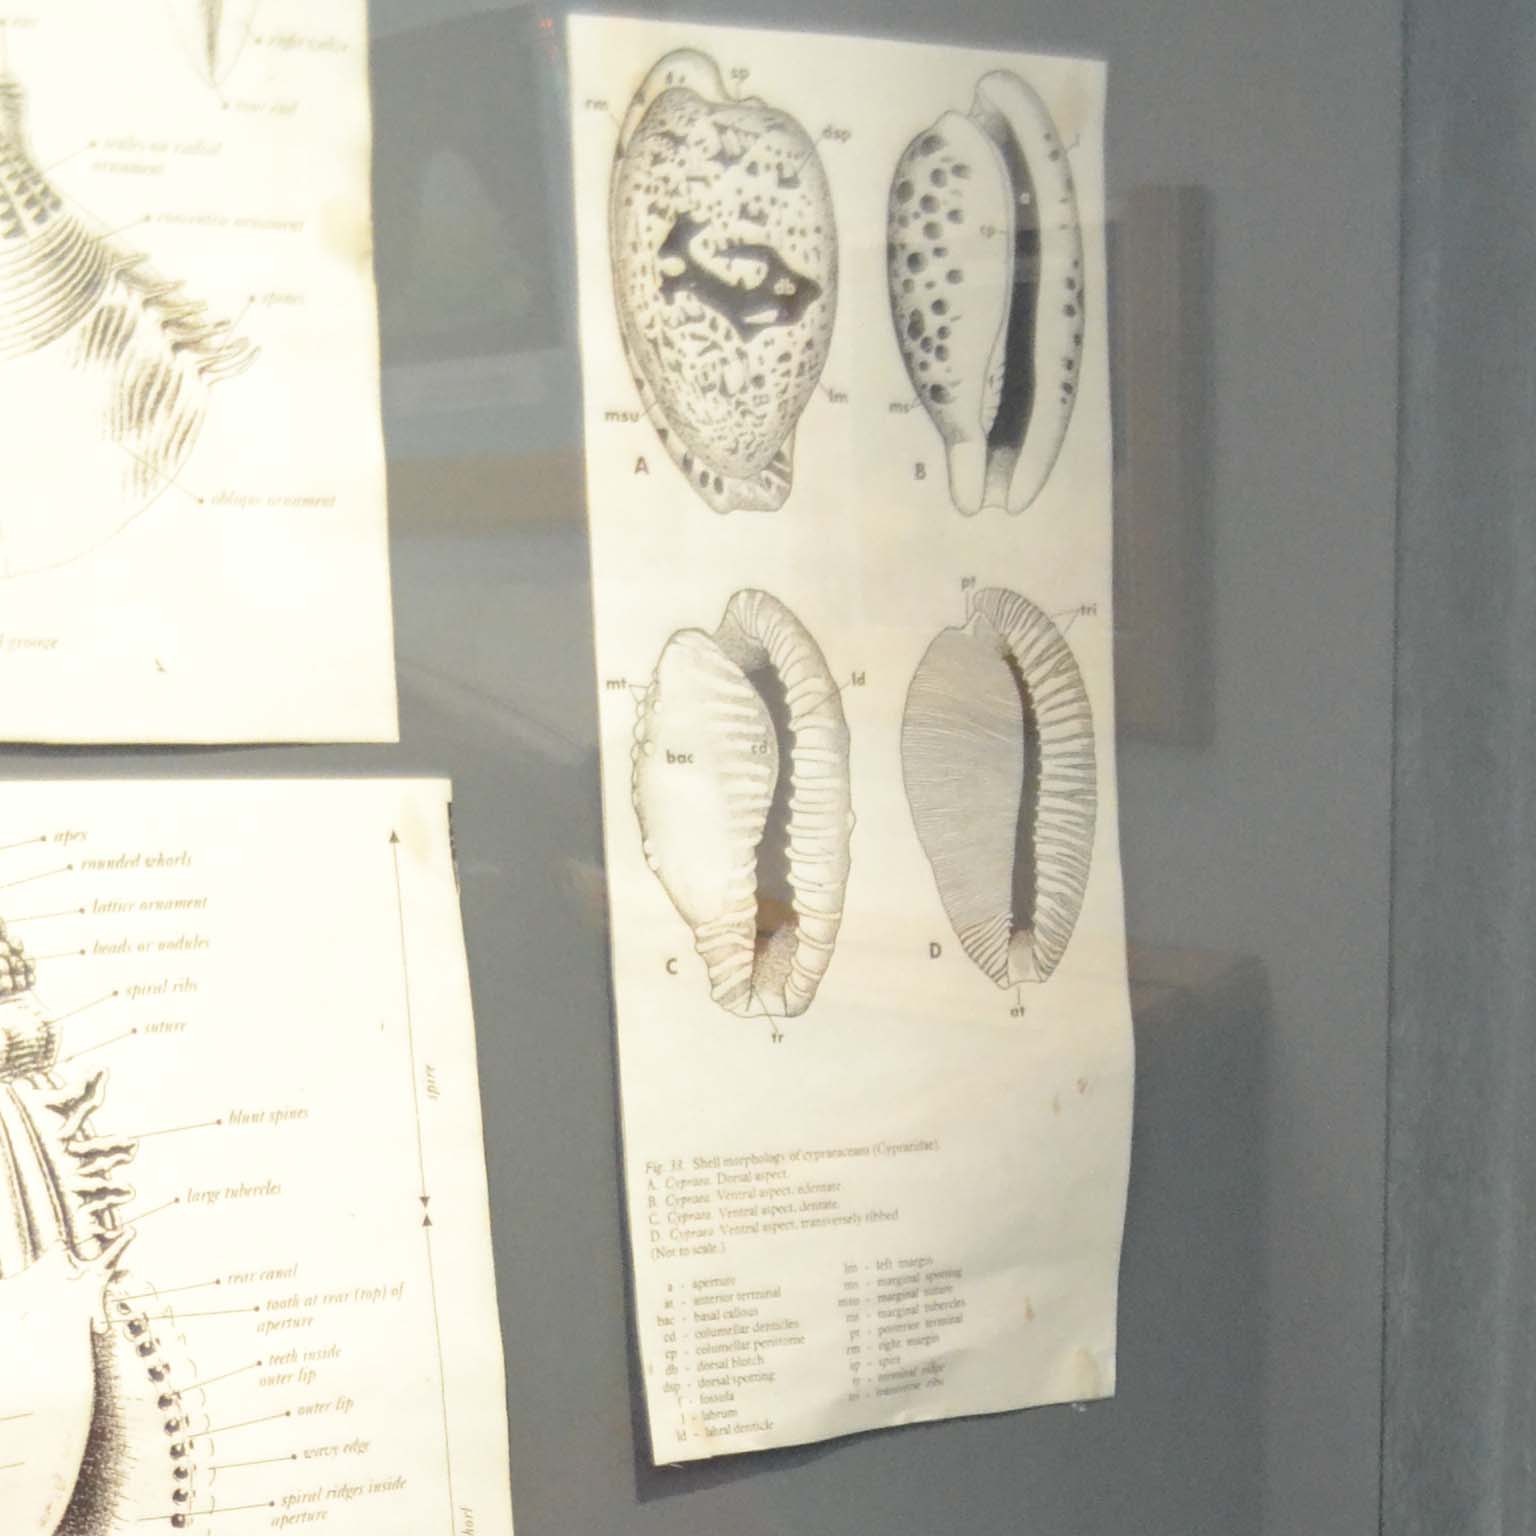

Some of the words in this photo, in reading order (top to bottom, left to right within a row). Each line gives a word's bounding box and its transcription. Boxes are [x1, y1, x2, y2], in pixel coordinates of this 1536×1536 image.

[634, 456, 650, 475] A
[914, 462, 927, 480] B
[606, 677, 629, 690] mt
[851, 671, 866, 687] ld
[666, 750, 695, 766] bac
[53, 830, 88, 847] apex
[80, 853, 141, 871] rounded
[144, 851, 192, 869] whorls
[92, 898, 135, 914] lattice
[138, 897, 208, 912] ornament
[136, 943, 153, 953] or
[157, 932, 211, 953] nodules
[929, 943, 942, 960] D
[665, 956, 679, 976] C
[125, 978, 169, 1000] spiral
[172, 977, 198, 993] ribs
[145, 1020, 189, 1033] suture
[228, 1109, 266, 1126] blunt
[269, 1107, 309, 1127] spines
[693, 1156, 720, 1170] Shell
[789, 1149, 801, 1162] of
[717, 1170, 752, 1185] Dorsal
[187, 1187, 221, 1206] large
[225, 1179, 281, 1199] tubercles
[717, 1187, 755, 1201] Ventral
[719, 1204, 757, 1218] Ventral
[720, 1220, 759, 1235] Ventral
[800, 1212, 862, 1229] transversely
[227, 1273, 256, 1284] rear
[259, 1262, 298, 1281] canal
[265, 1293, 299, 1311] tooth
[304, 1296, 318, 1307] at
[322, 1293, 351, 1305] rear
[354, 1287, 386, 1304] (top)
[391, 1280, 406, 1300] of
[736, 1286, 782, 1302] terminal
[693, 1308, 720, 1322] basal
[256, 1317, 314, 1336] aperture
[695, 1322, 750, 1339] columellar
[753, 1317, 799, 1332] denticles
[268, 1348, 297, 1366] teeth
[303, 1343, 342, 1362] inside
[696, 1339, 751, 1355] columellar
[697, 1357, 729, 1372] dorsal
[258, 1373, 294, 1387] outer
[297, 1367, 316, 1386] lip
[697, 1373, 730, 1388] dorsal
[297, 1402, 333, 1416] outer
[335, 1394, 354, 1413] lip
[701, 1408, 738, 1421] labrum
[704, 1423, 731, 1438] labral
[733, 1419, 774, 1435] denticle
[281, 1488, 322, 1509] spiral
[325, 1482, 364, 1502] ridges
[368, 1474, 408, 1494] inside
[270, 1509, 329, 1530] aperture
